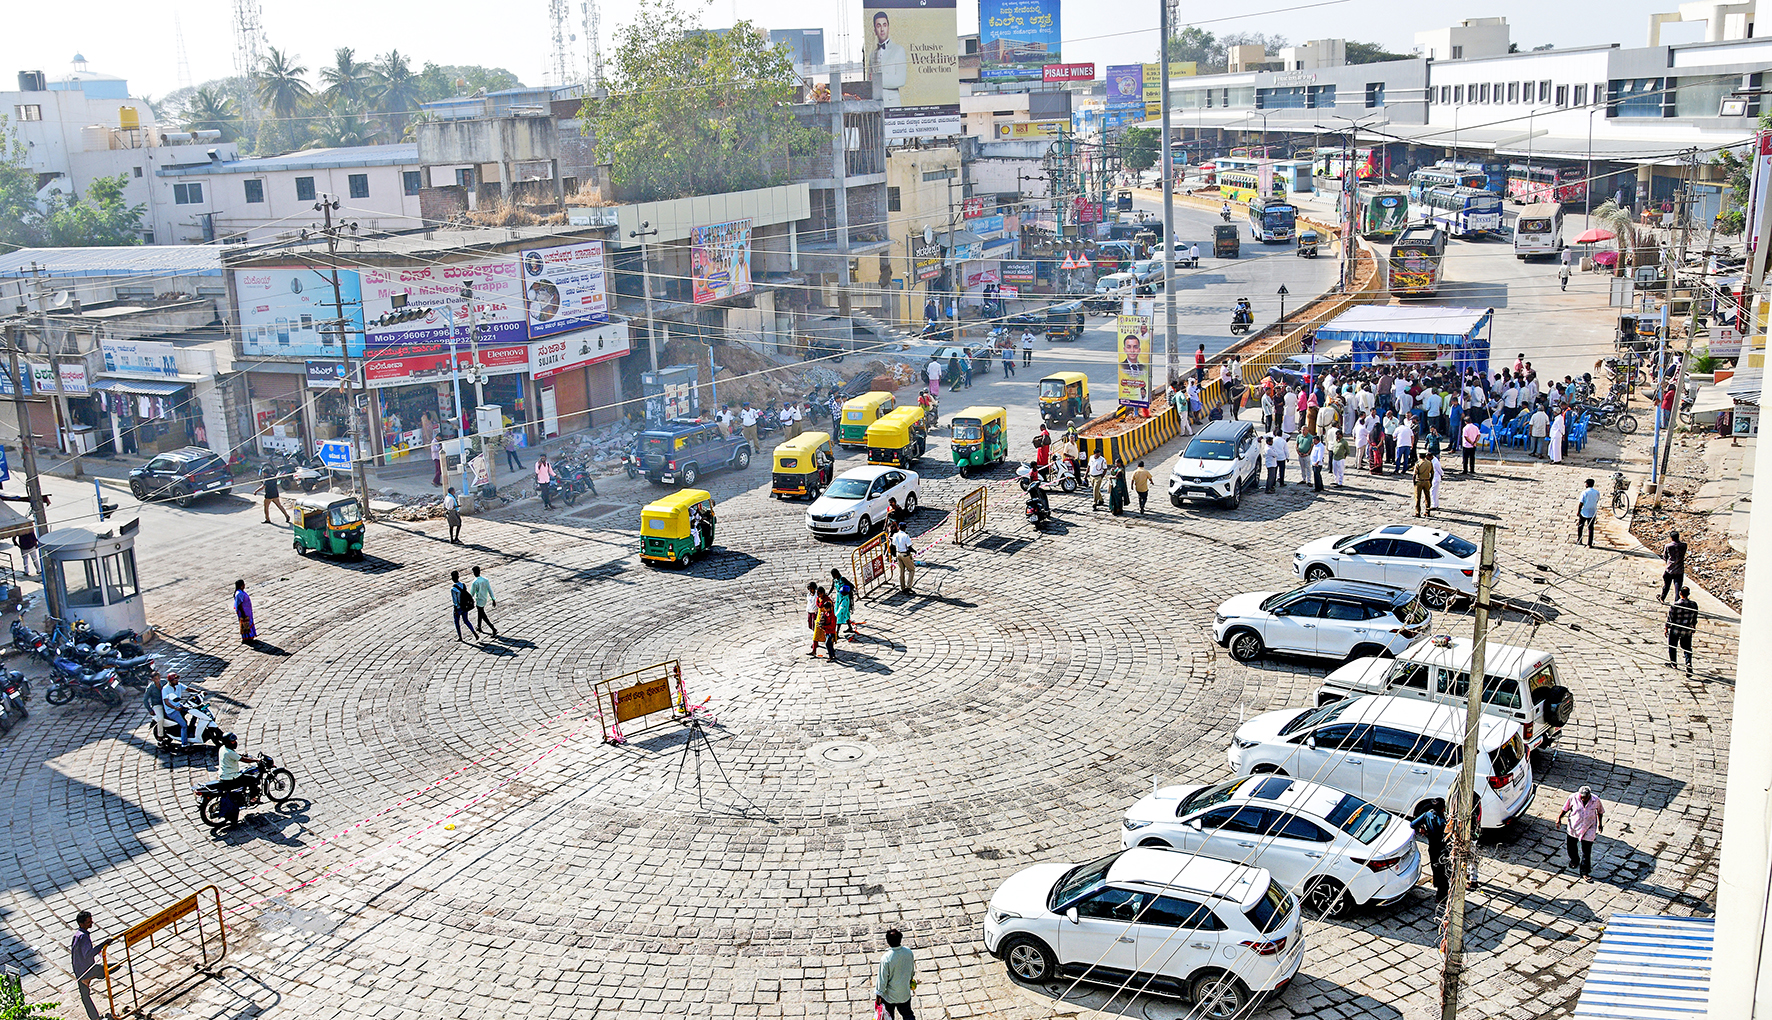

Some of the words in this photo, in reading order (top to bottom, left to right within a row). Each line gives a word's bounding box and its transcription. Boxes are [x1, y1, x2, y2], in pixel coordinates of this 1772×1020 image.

[910, 43, 943, 52] Exclusive
[911, 53, 956, 66] Wedding
[918, 65, 951, 74] Collection
[1045, 68, 1069, 78] PISALE
[1070, 67, 1093, 76] WINES
[420, 281, 509, 295] Mahesharappa
[406, 298, 445, 307] Authorised
[375, 334, 395, 342] Mob
[403, 331, 430, 340] 96067
[433, 329, 462, 337] 9968,
[465, 327, 491, 336] 912
[493, 322, 520, 332] 61000
[487, 348, 524, 359] Eleenova
[538, 339, 566, 356] ಸುಜಾತ
[538, 354, 558, 367] SUJATA
